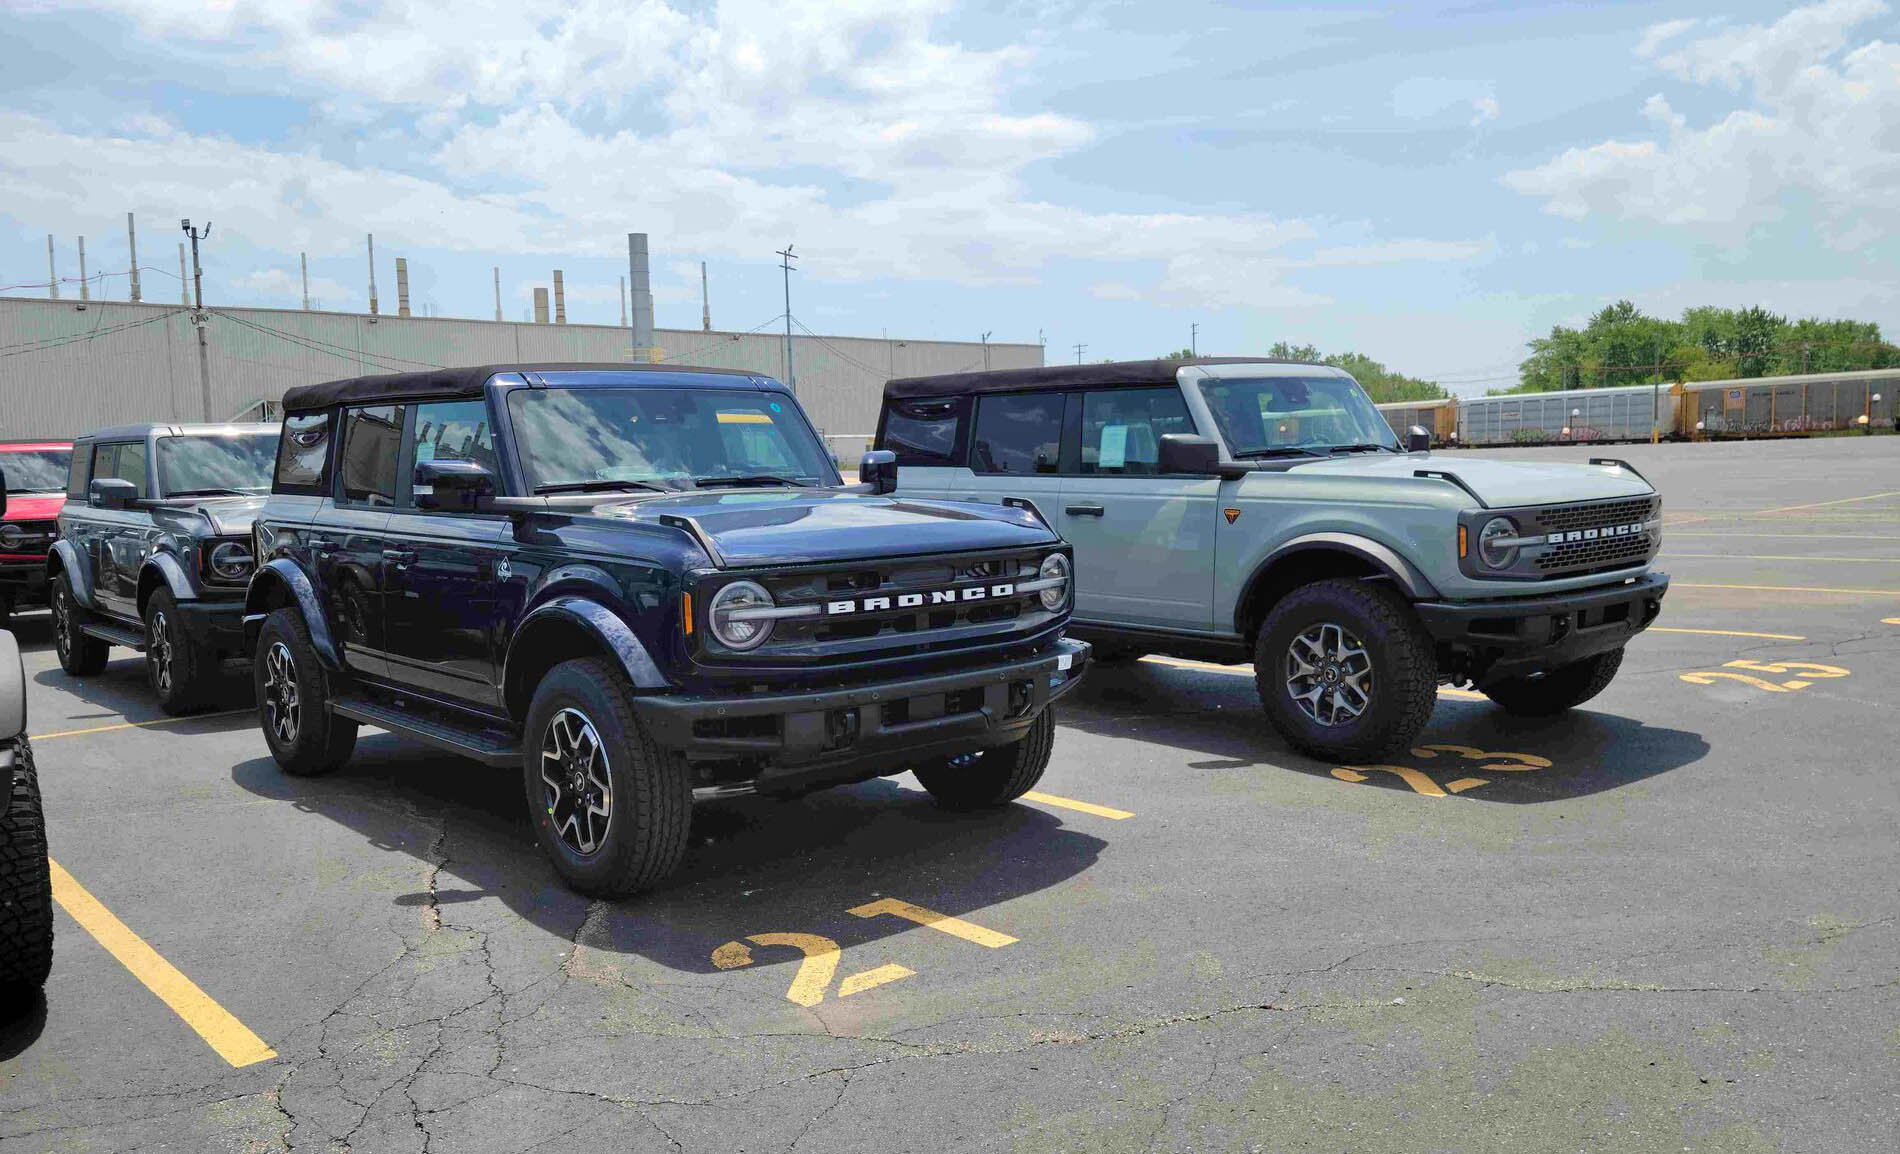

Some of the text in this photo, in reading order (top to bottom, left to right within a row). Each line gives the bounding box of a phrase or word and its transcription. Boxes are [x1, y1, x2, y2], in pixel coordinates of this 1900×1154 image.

[1548, 523, 1642, 544] BRONCO
[828, 584, 1014, 615] BRONCO
[1679, 659, 1851, 692] 25
[1330, 744, 1552, 798] 23
[711, 897, 1020, 1008] 21
